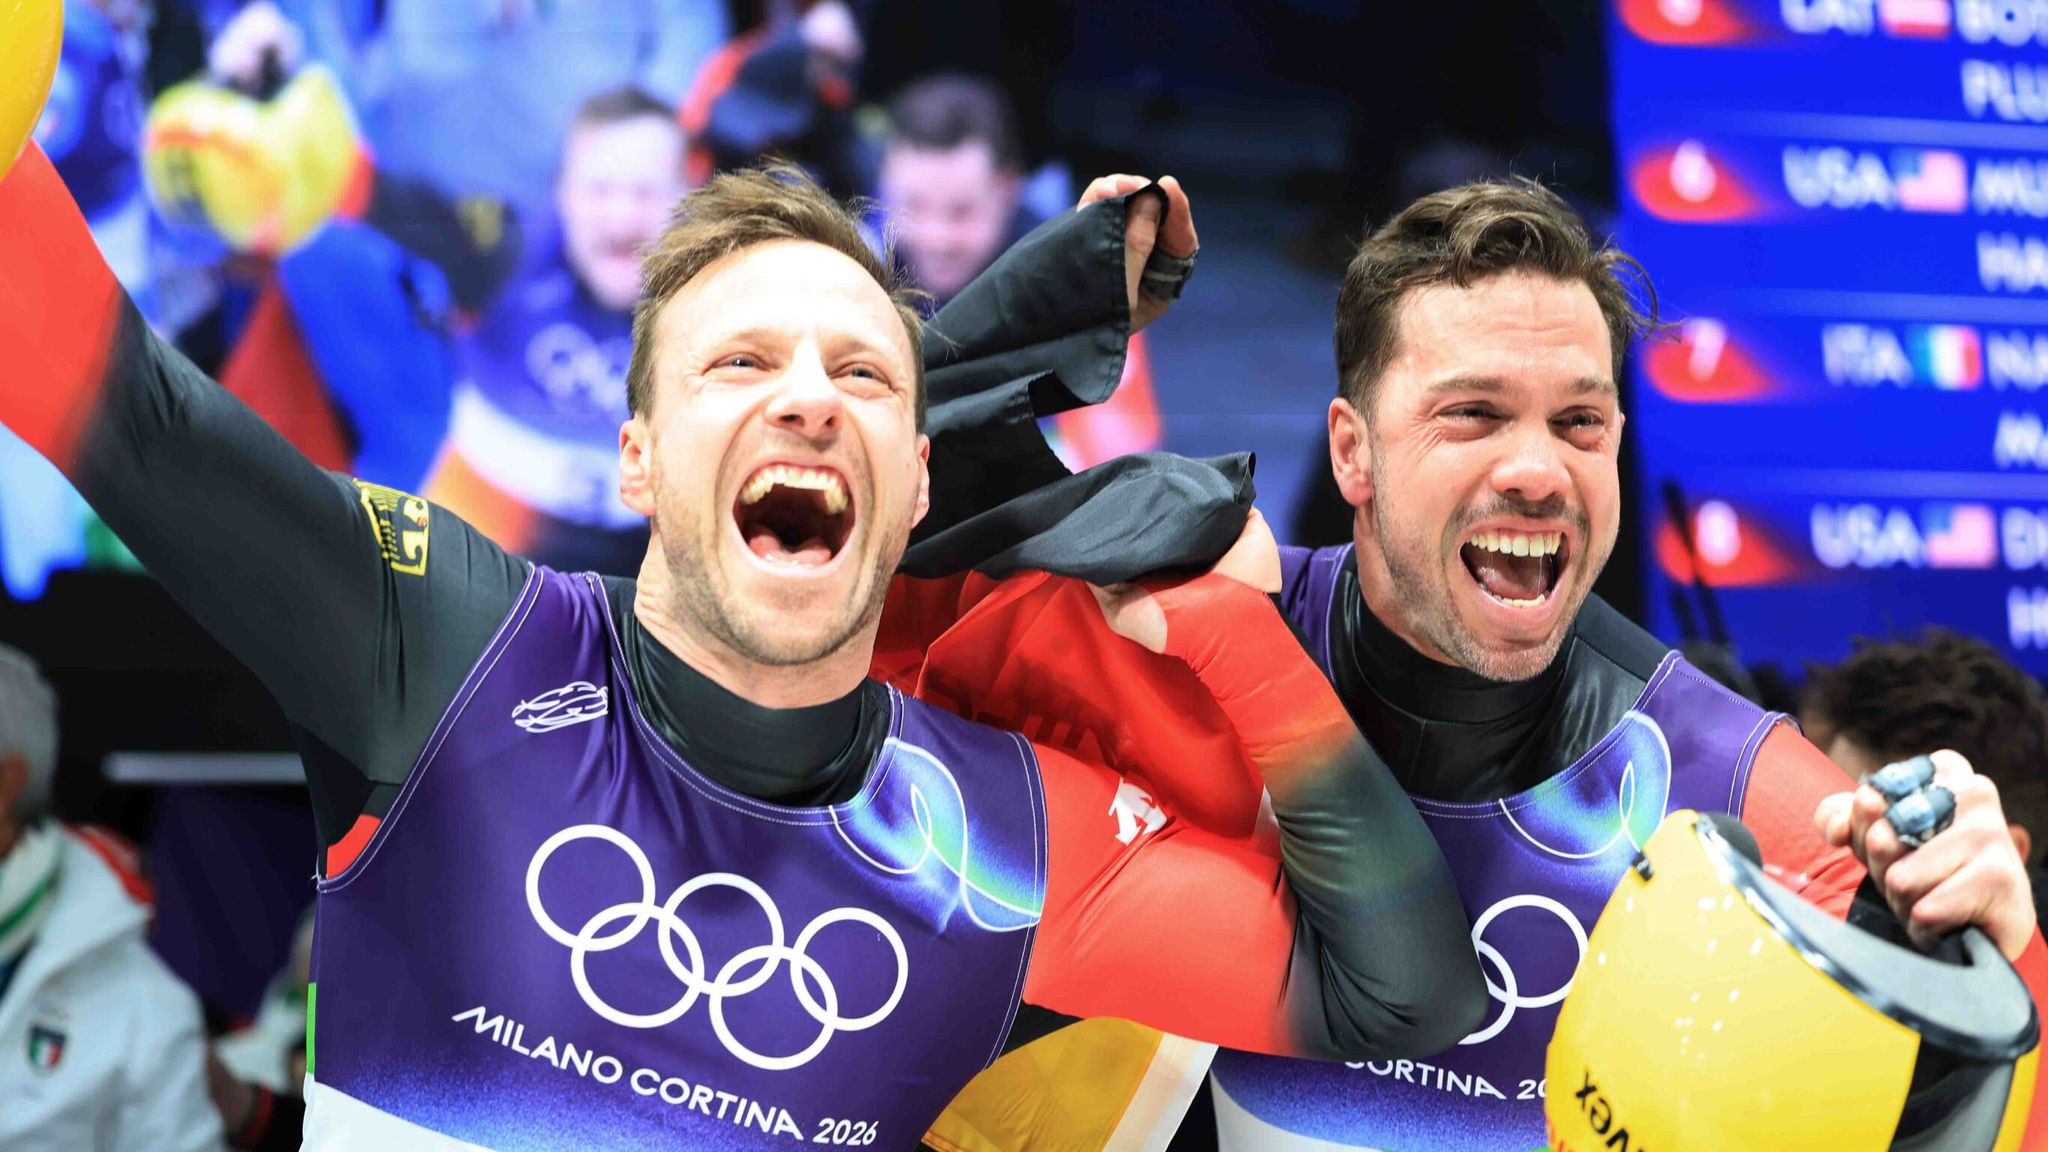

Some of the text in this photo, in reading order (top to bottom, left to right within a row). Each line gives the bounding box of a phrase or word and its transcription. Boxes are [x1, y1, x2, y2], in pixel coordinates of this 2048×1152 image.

[1670, 139, 1716, 203] 6
[1783, 145, 1898, 209] USA
[1683, 316, 1726, 384] 7
[1823, 323, 1912, 386] ITA
[1696, 500, 1741, 566] 8
[1811, 503, 1925, 568] USA
[451, 1006, 878, 1146] MILANO CORTINA 2026
[1345, 1059, 1507, 1099] ORTINA
